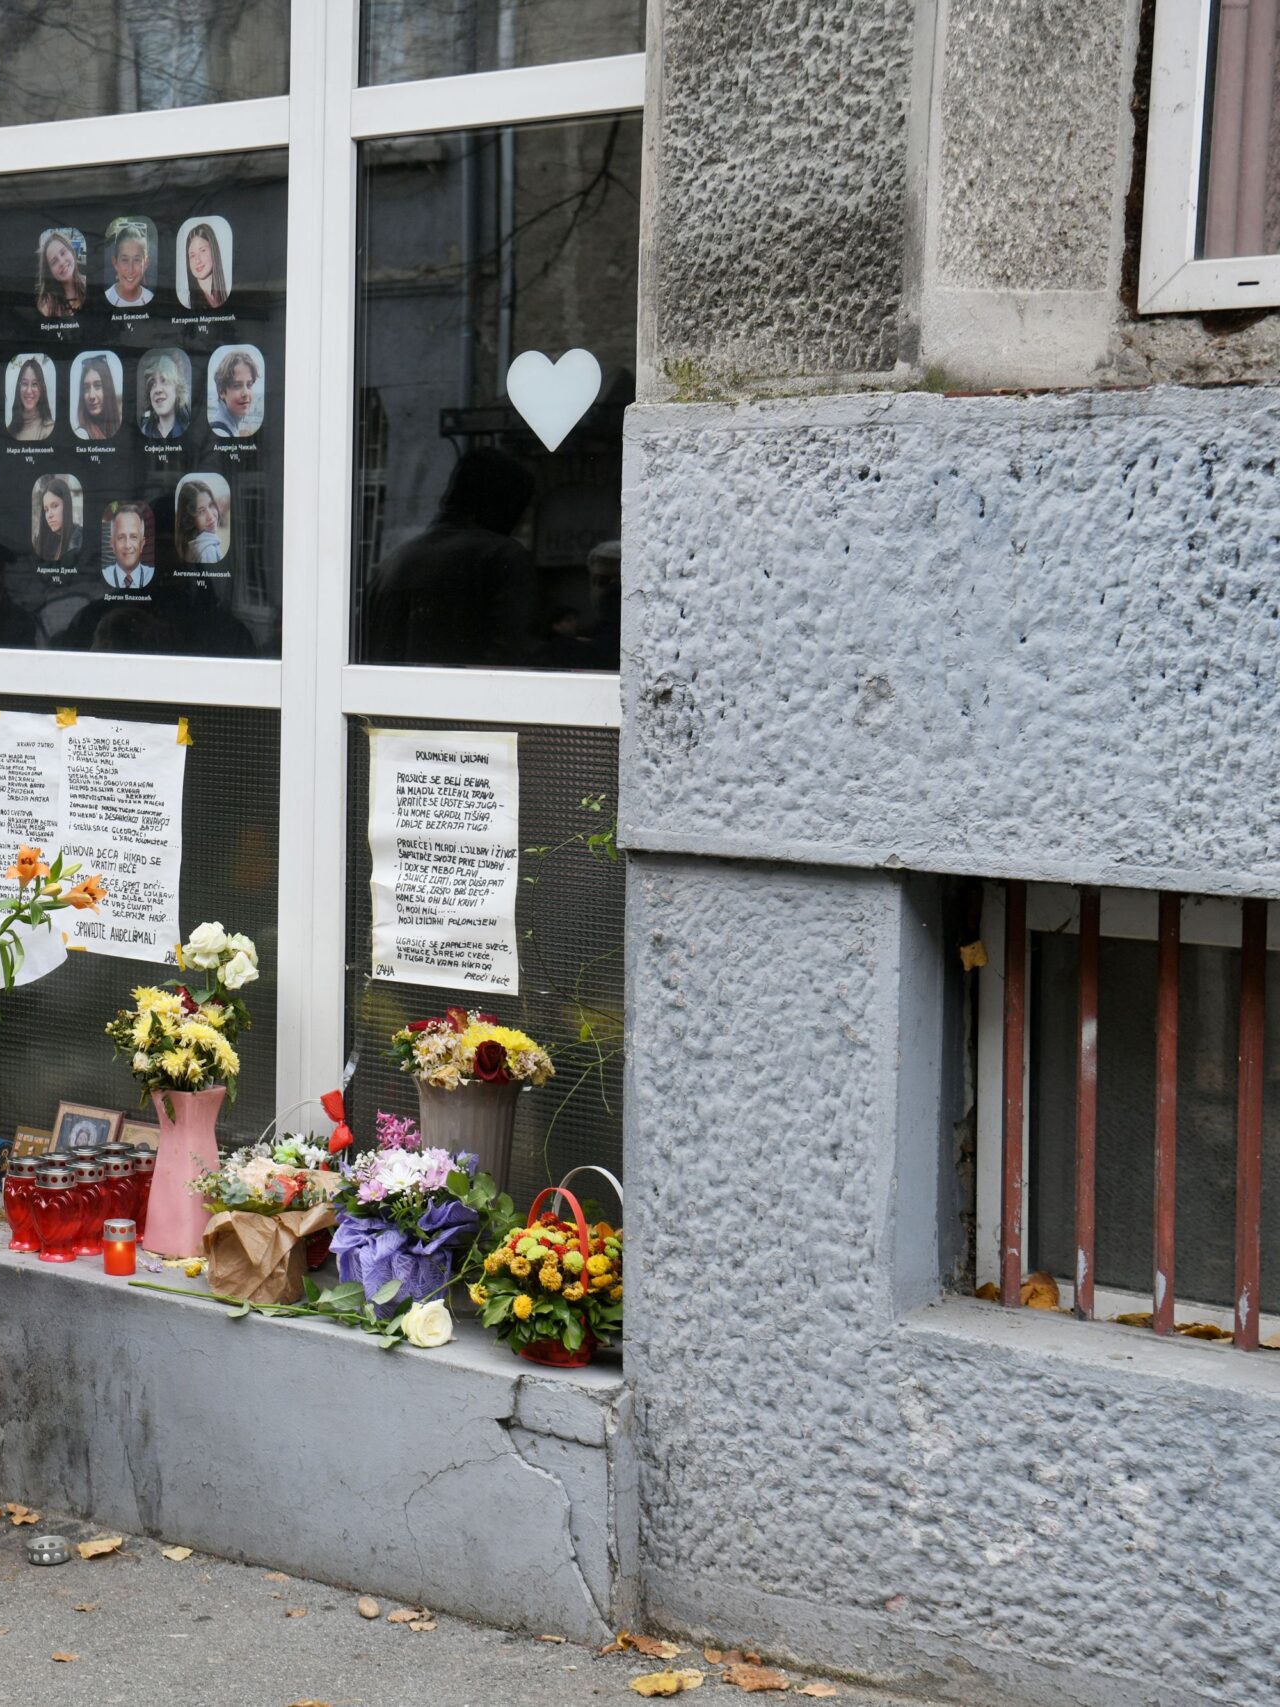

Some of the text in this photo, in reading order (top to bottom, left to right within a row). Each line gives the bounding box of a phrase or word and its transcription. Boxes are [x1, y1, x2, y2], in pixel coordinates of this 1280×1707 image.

[429, 776, 441, 784] SE
[444, 774, 462, 786] BELI
[428, 797, 438, 807] SE
[440, 798, 463, 808] LASTE
[475, 801, 497, 810] JUGA
[434, 810, 461, 820] GRADU
[96, 848, 118, 860] DECA
[149, 856, 162, 866] SE
[433, 855, 457, 864] SVOJE
[458, 857, 475, 868] PRVE
[478, 860, 505, 871] LJUBAVI
[419, 866, 429, 874] SE
[432, 866, 454, 875] NEBO
[468, 888, 490, 896] DECA
[442, 896, 455, 906] BILI
[74, 921, 106, 940] SPAVAJTE
[429, 941, 438, 949] SE
[425, 956, 435, 964] ZA
